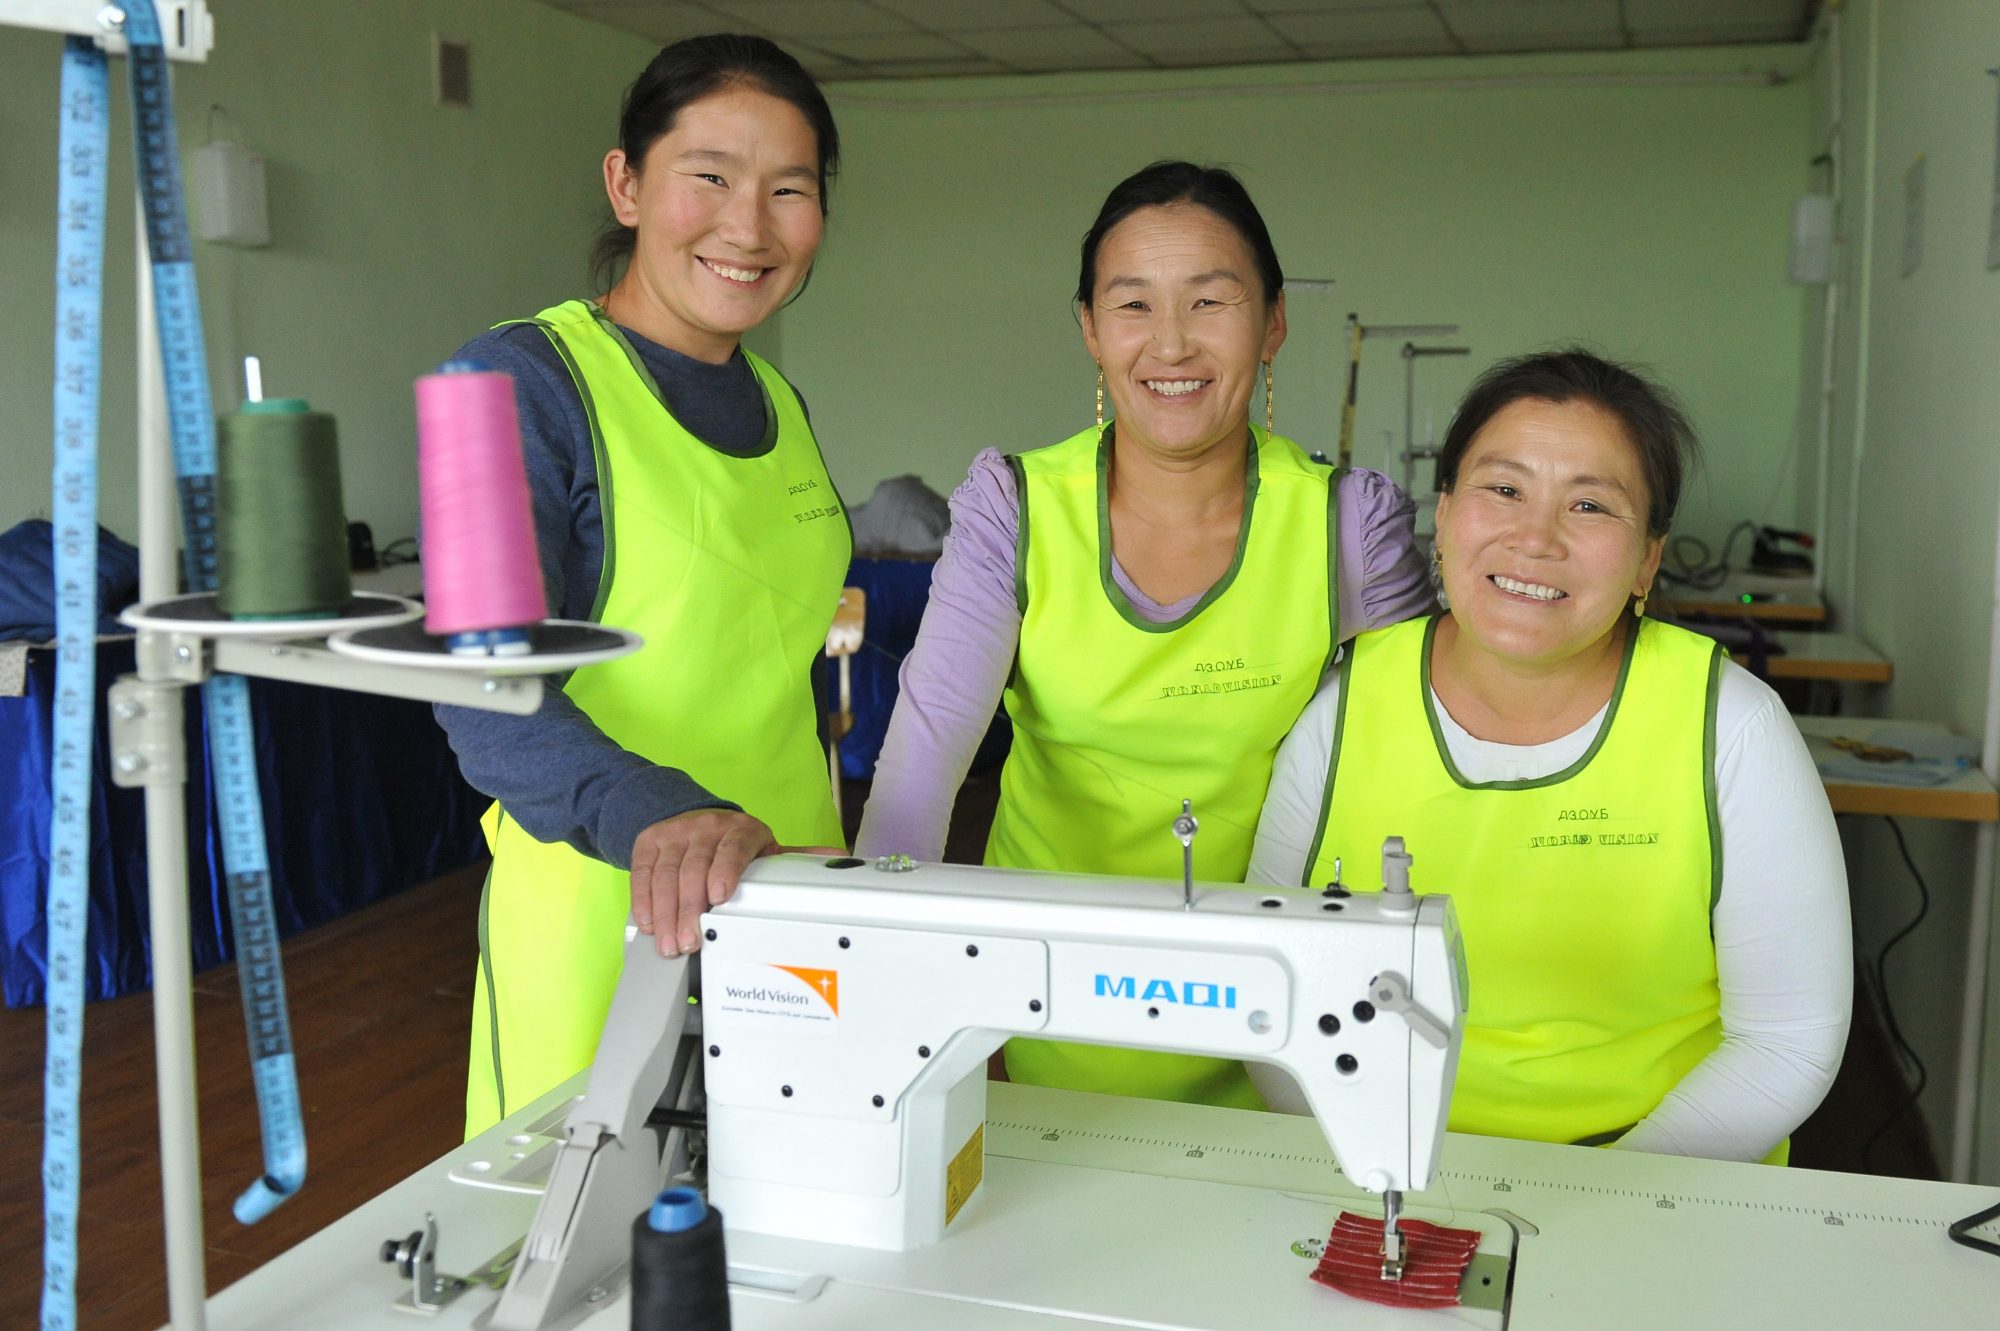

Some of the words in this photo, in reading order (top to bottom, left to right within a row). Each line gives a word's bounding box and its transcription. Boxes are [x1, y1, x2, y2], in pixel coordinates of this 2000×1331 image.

[72, 91, 94, 122] 32
[71, 146, 91, 177] 33
[69, 200, 90, 231] 34
[67, 255, 88, 287] 35
[64, 364, 84, 395] 37
[1530, 834, 1592, 848] WORLD
[1599, 832, 1659, 846] VISION
[726, 986, 765, 1001] World
[767, 990, 809, 1005] Vision
[1094, 973, 1238, 1009] MAQI
